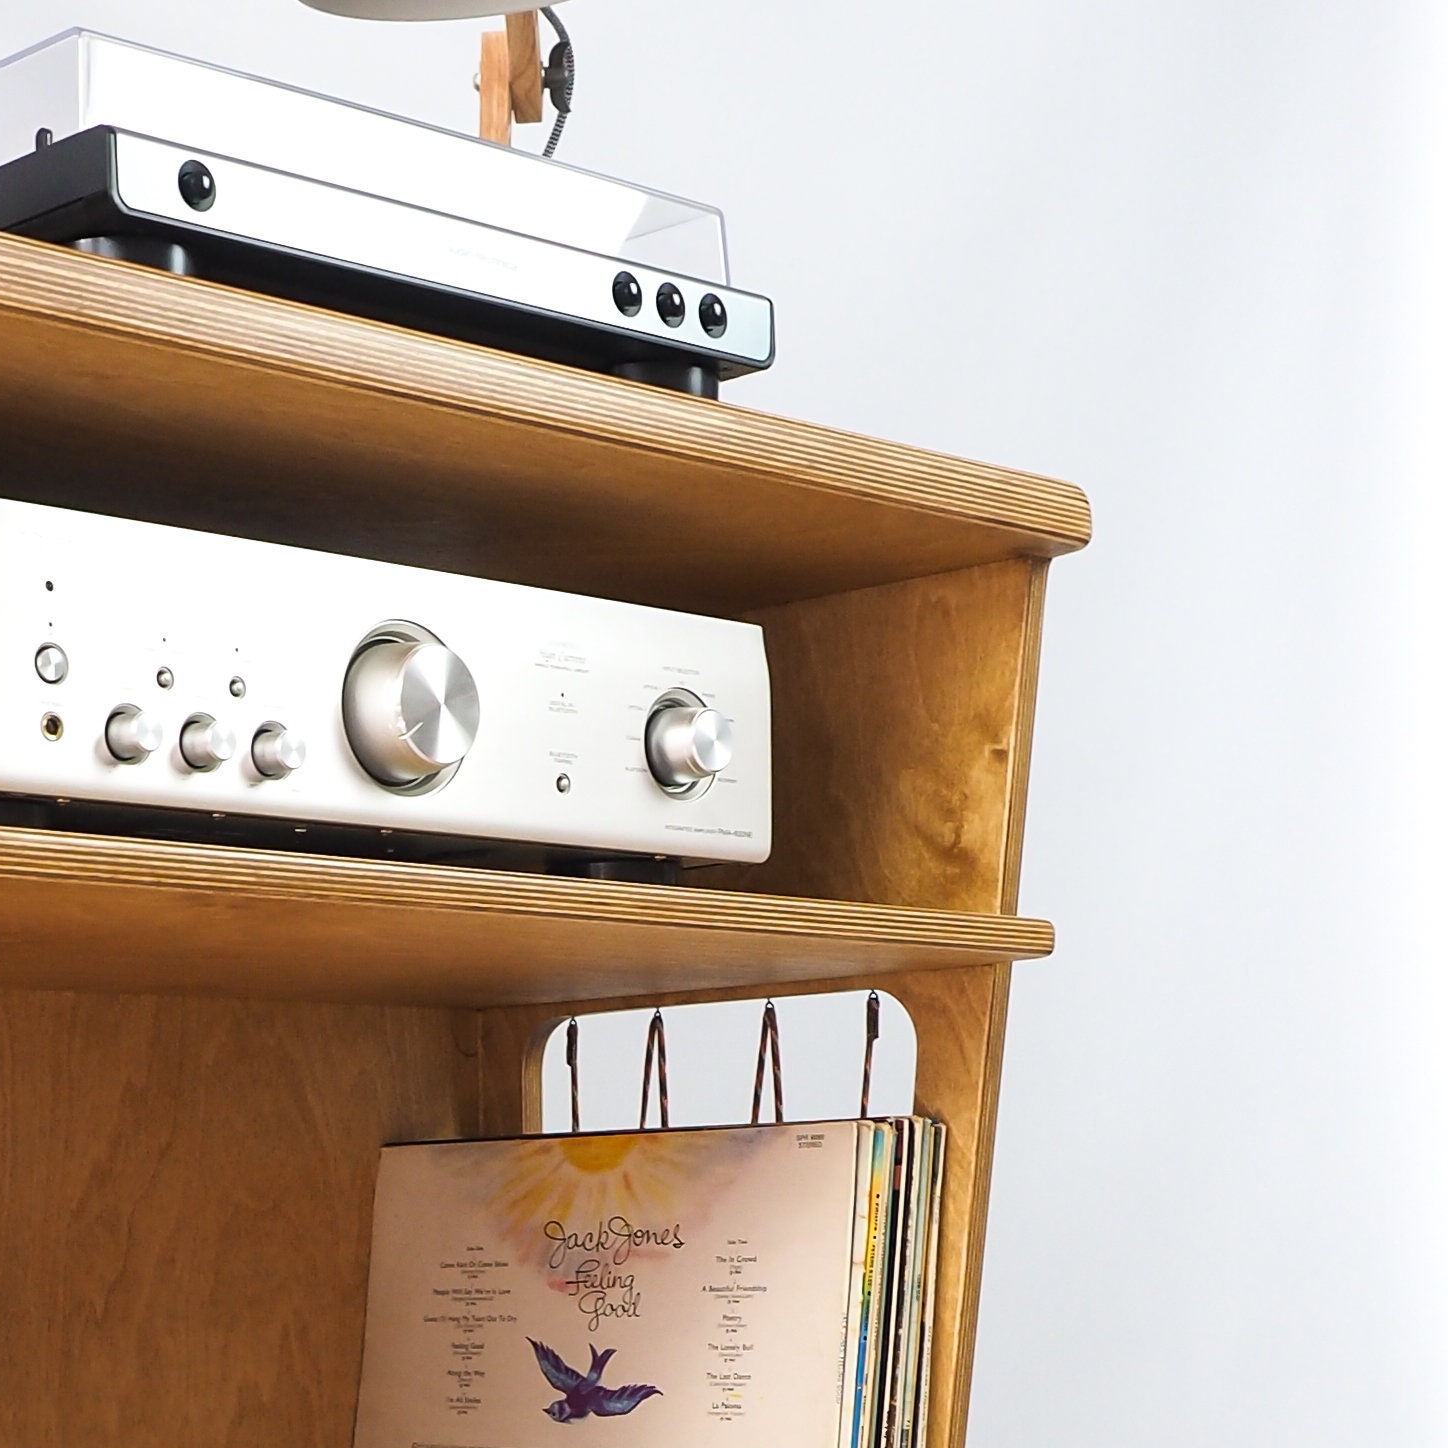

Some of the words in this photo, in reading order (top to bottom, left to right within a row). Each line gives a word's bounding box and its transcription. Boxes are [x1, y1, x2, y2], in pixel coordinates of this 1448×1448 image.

[543, 1220, 612, 1269] Jack
[608, 1216, 685, 1265] Jones
[566, 1259, 635, 1302] Feeling
[578, 1290, 640, 1332] Good
